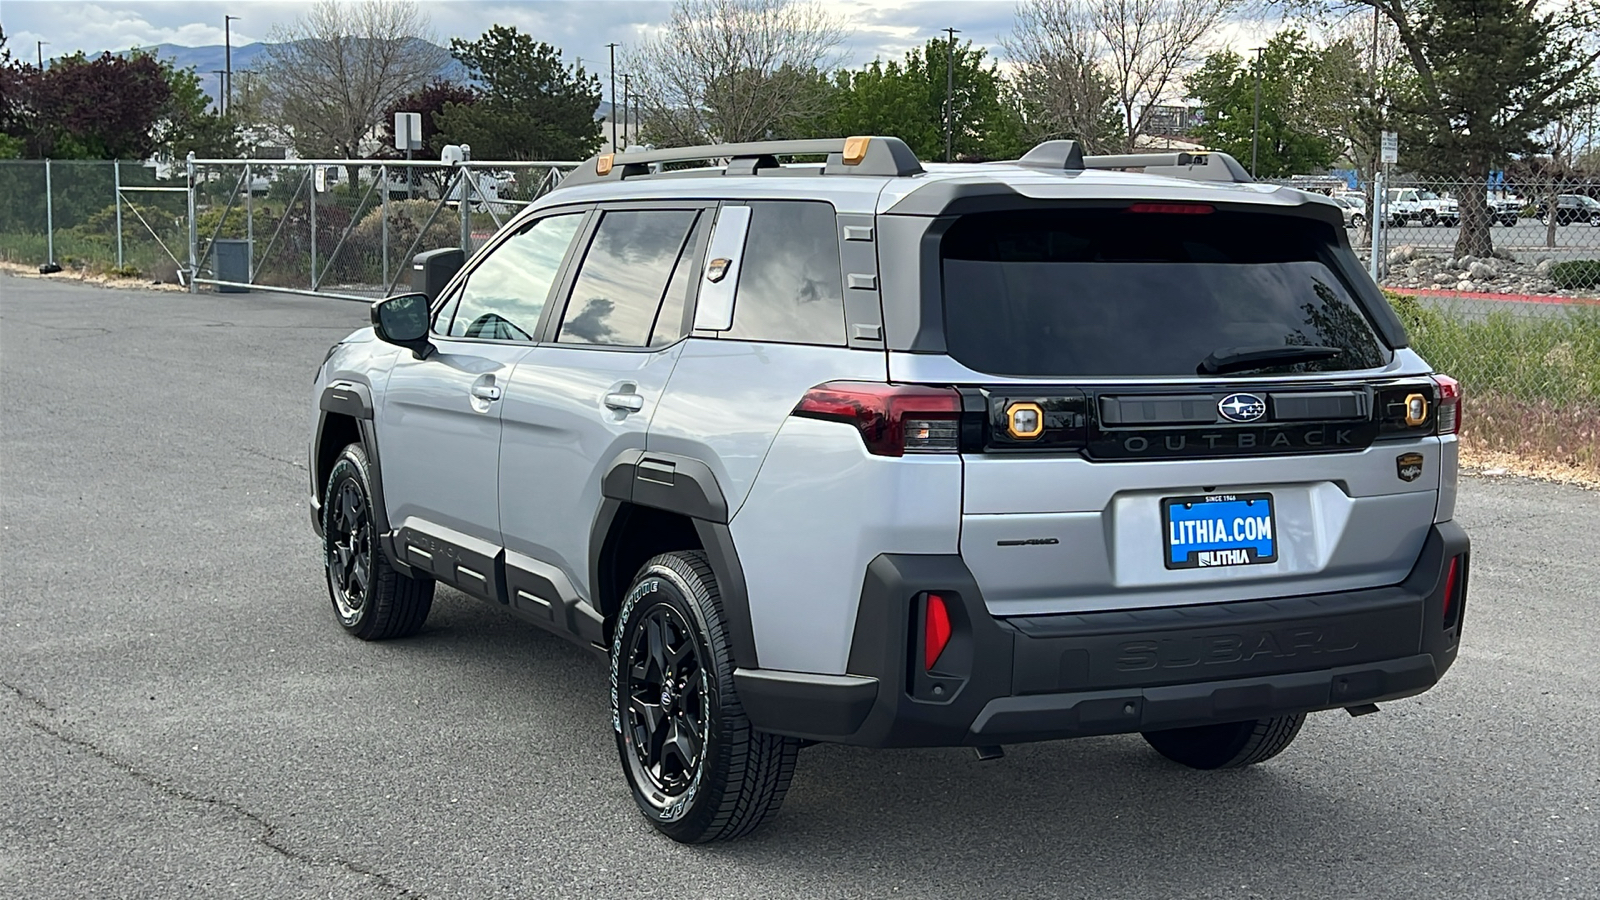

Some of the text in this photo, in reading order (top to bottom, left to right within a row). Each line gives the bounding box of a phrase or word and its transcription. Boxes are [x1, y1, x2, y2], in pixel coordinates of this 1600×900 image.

[1123, 429, 1352, 452] OUTBACK
[1170, 516, 1272, 545] LITHIA.COM
[1210, 549, 1250, 566] LITHIA
